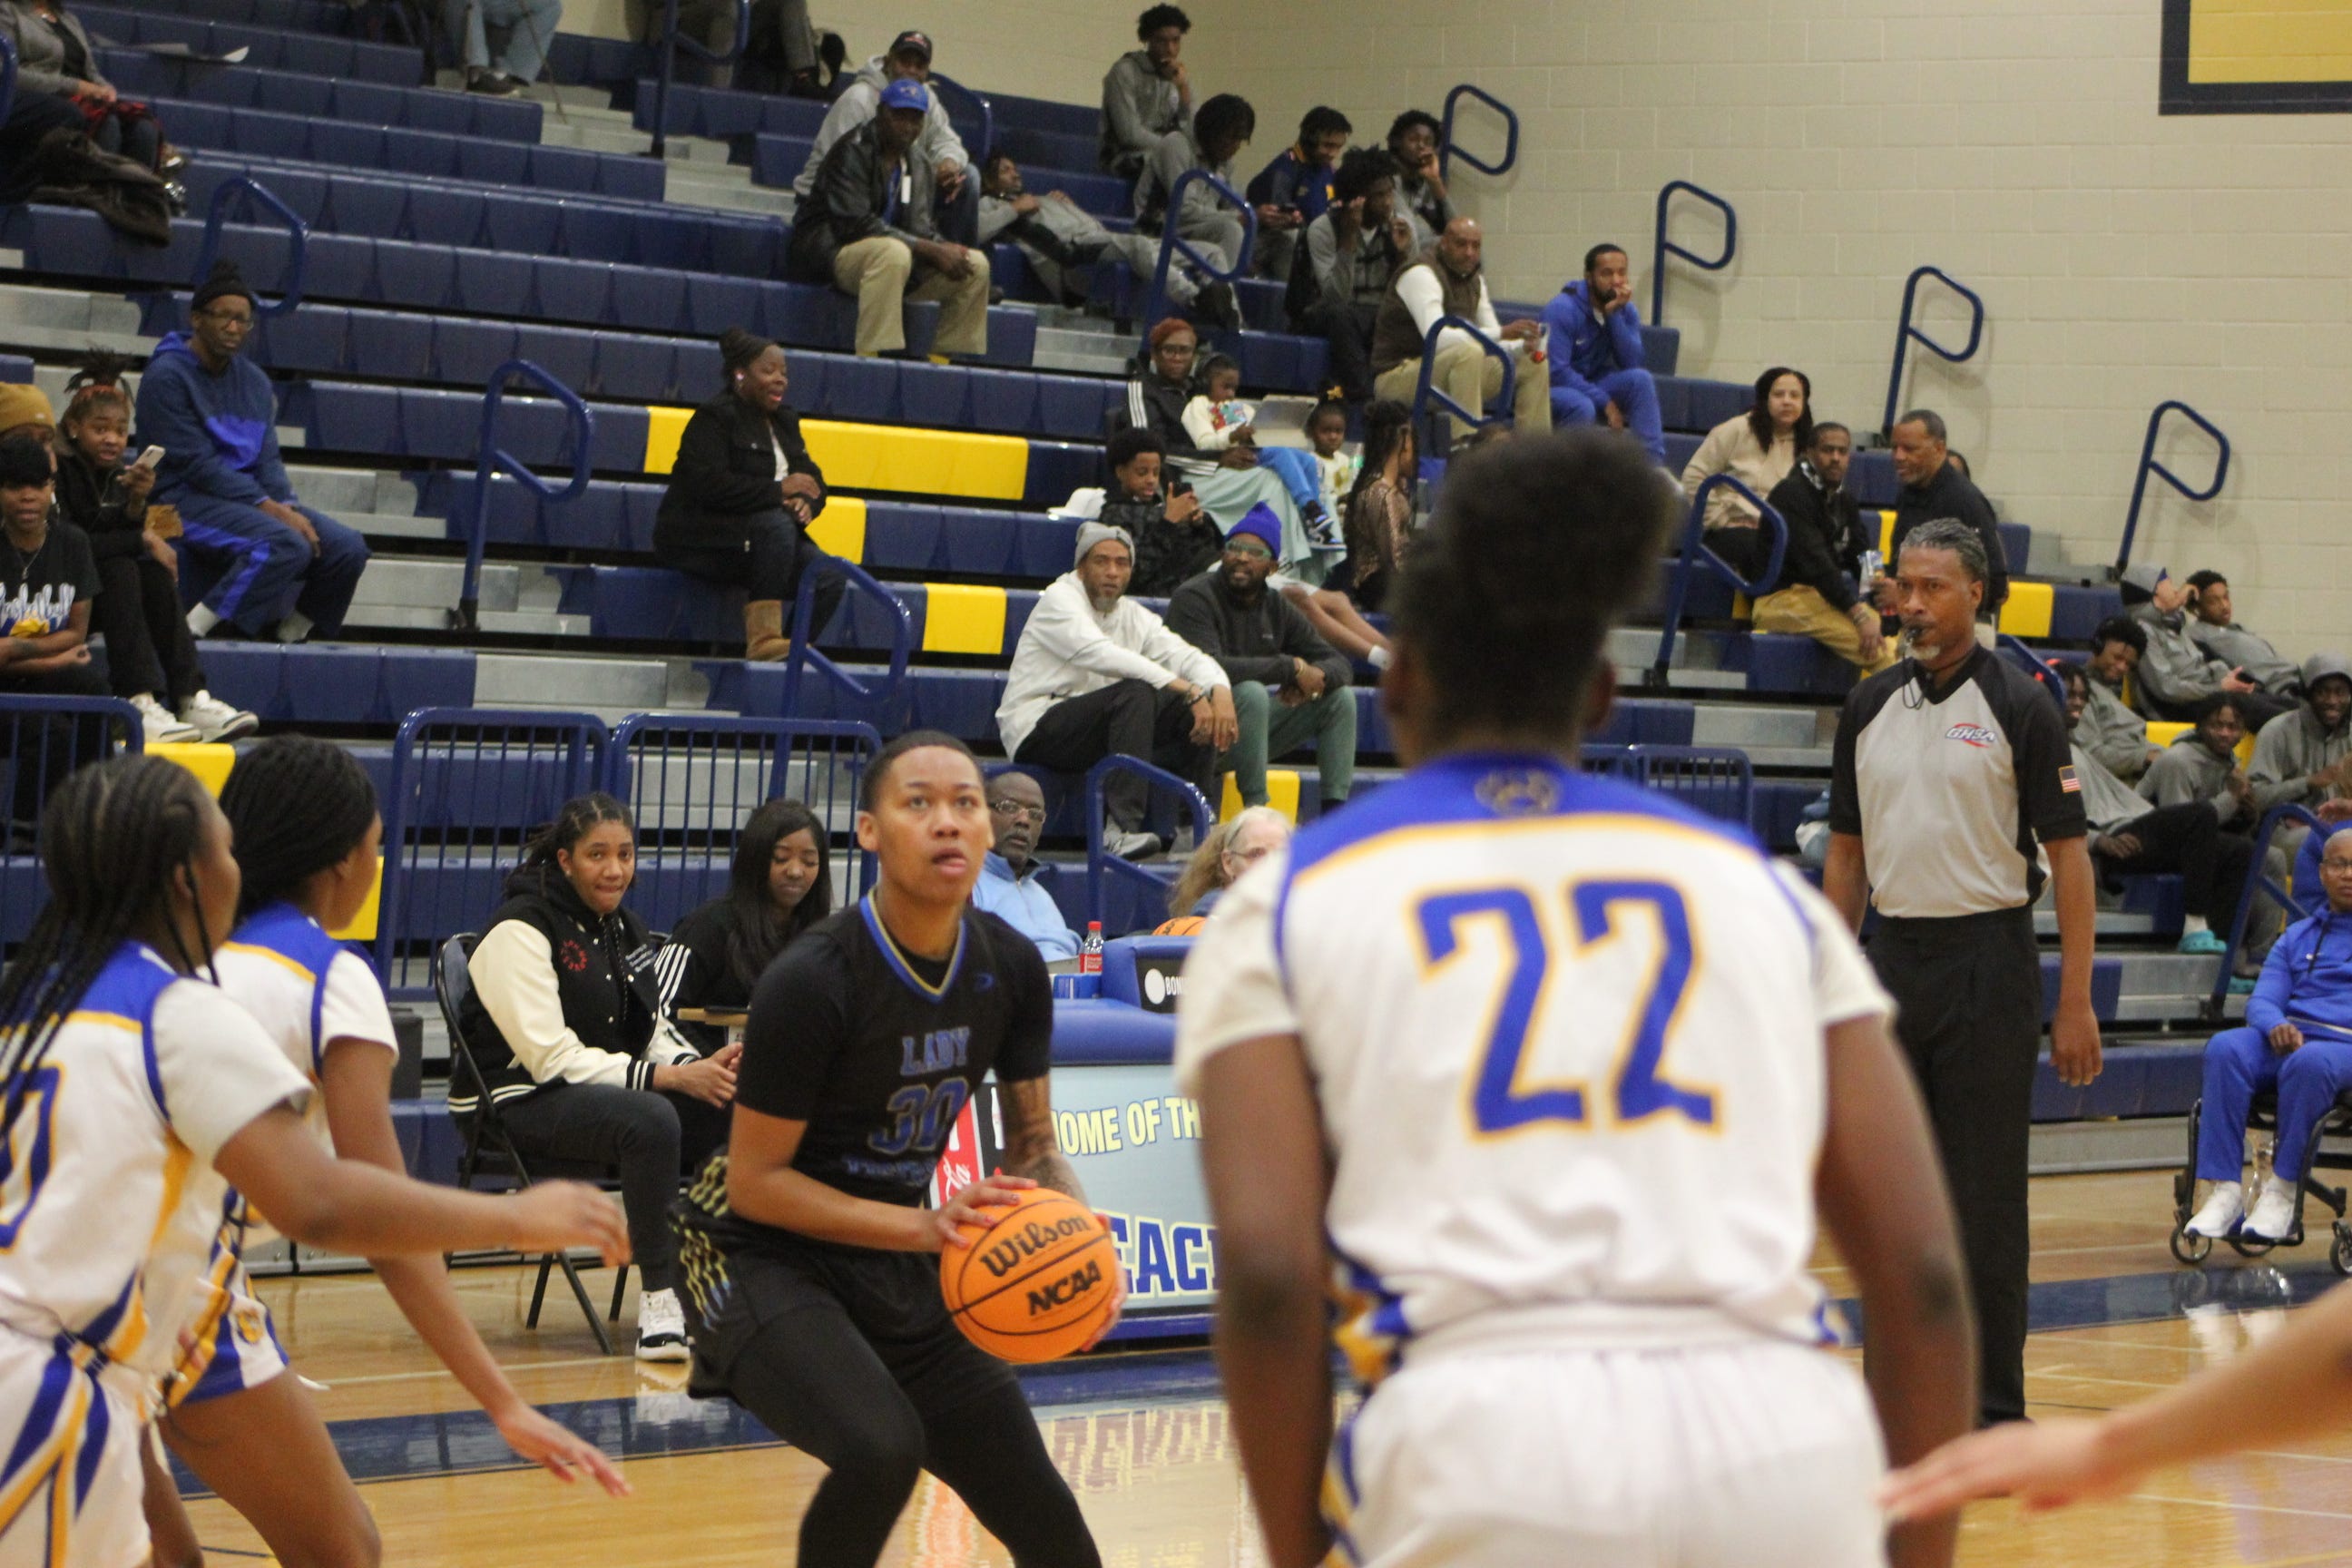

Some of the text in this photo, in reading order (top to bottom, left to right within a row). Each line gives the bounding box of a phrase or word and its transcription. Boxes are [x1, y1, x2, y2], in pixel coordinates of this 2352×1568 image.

[1945, 726, 1996, 742] GHSA
[1406, 874, 1724, 1142] 22
[900, 1026, 970, 1076] LADY
[867, 1076, 970, 1156] 30
[1126, 1097, 1162, 1147] OF
[1164, 1096, 1204, 1140] TH
[980, 1216, 1091, 1277] Wilson
[1026, 1259, 1103, 1316] NCAA
